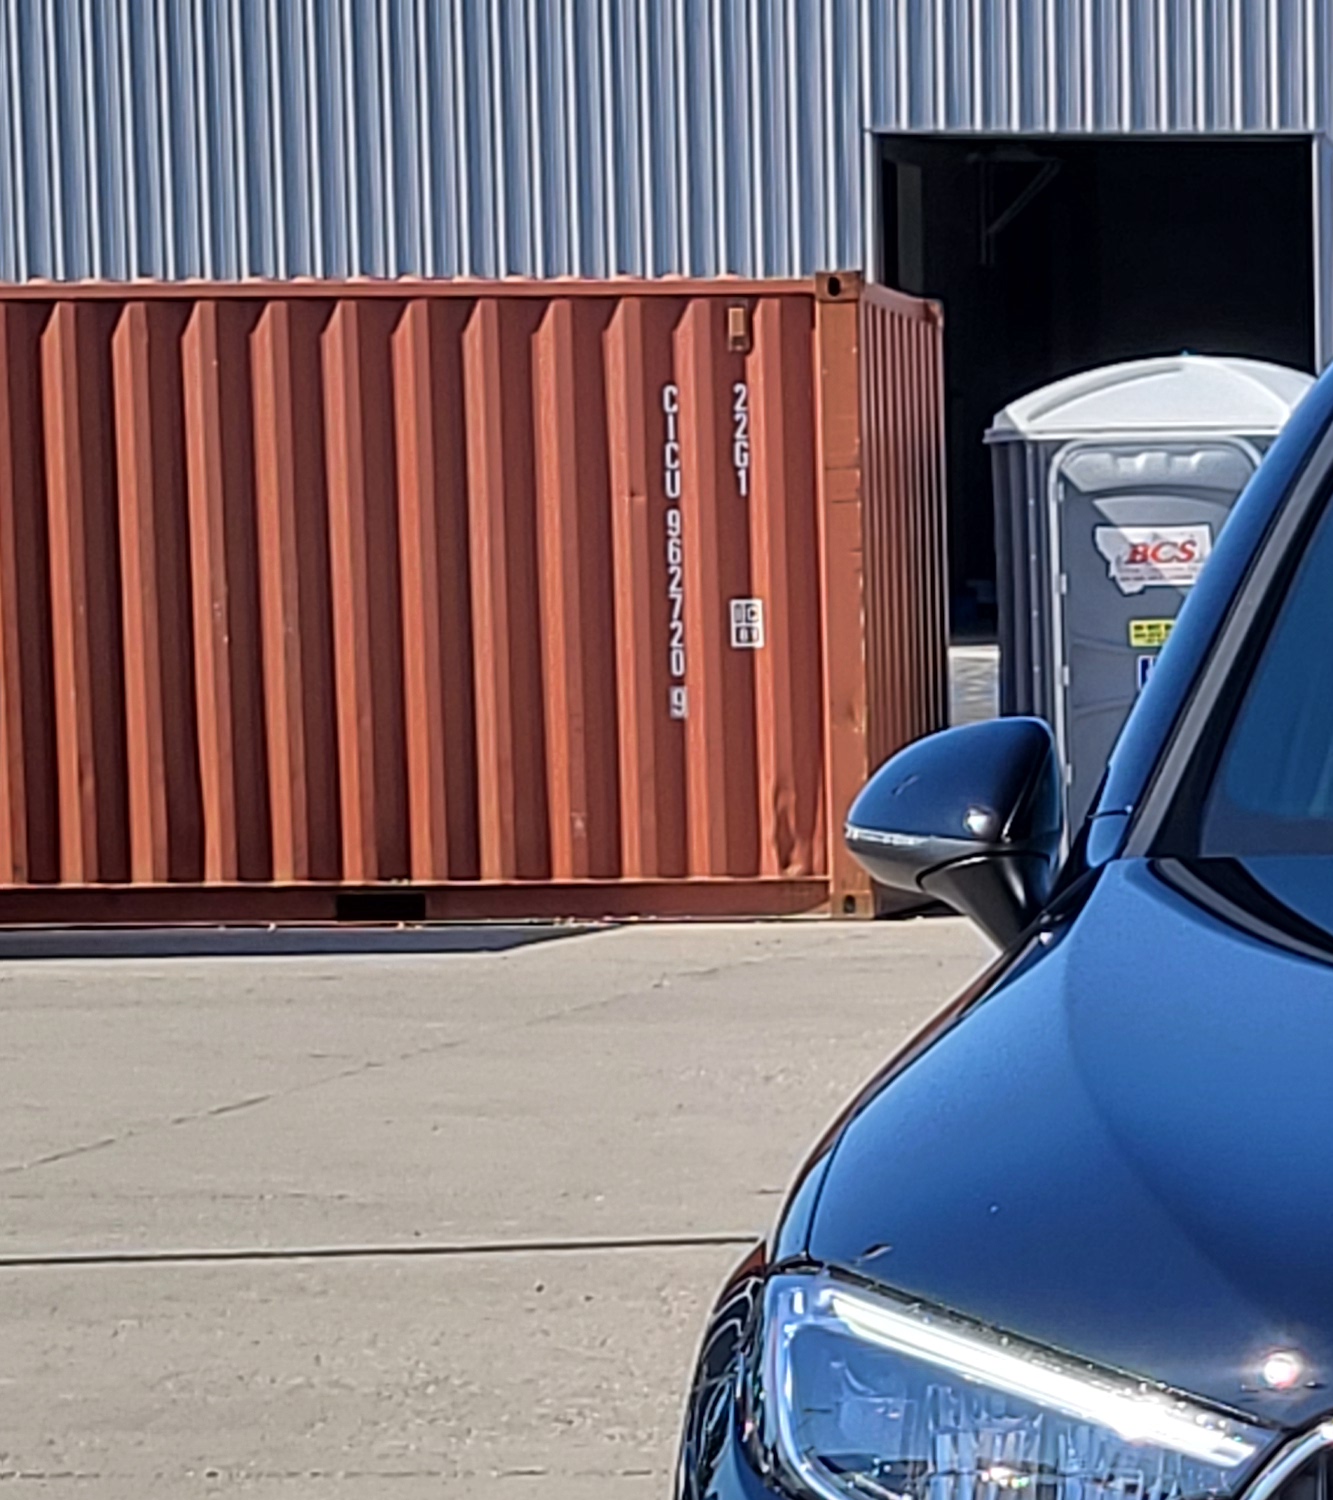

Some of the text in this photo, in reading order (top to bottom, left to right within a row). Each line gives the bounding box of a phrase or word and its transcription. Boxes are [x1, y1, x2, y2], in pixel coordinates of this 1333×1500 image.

[733, 383, 749, 496] 22G1
[663, 385, 688, 719] CICU 962720 9
[1125, 540, 1197, 564] BCS
